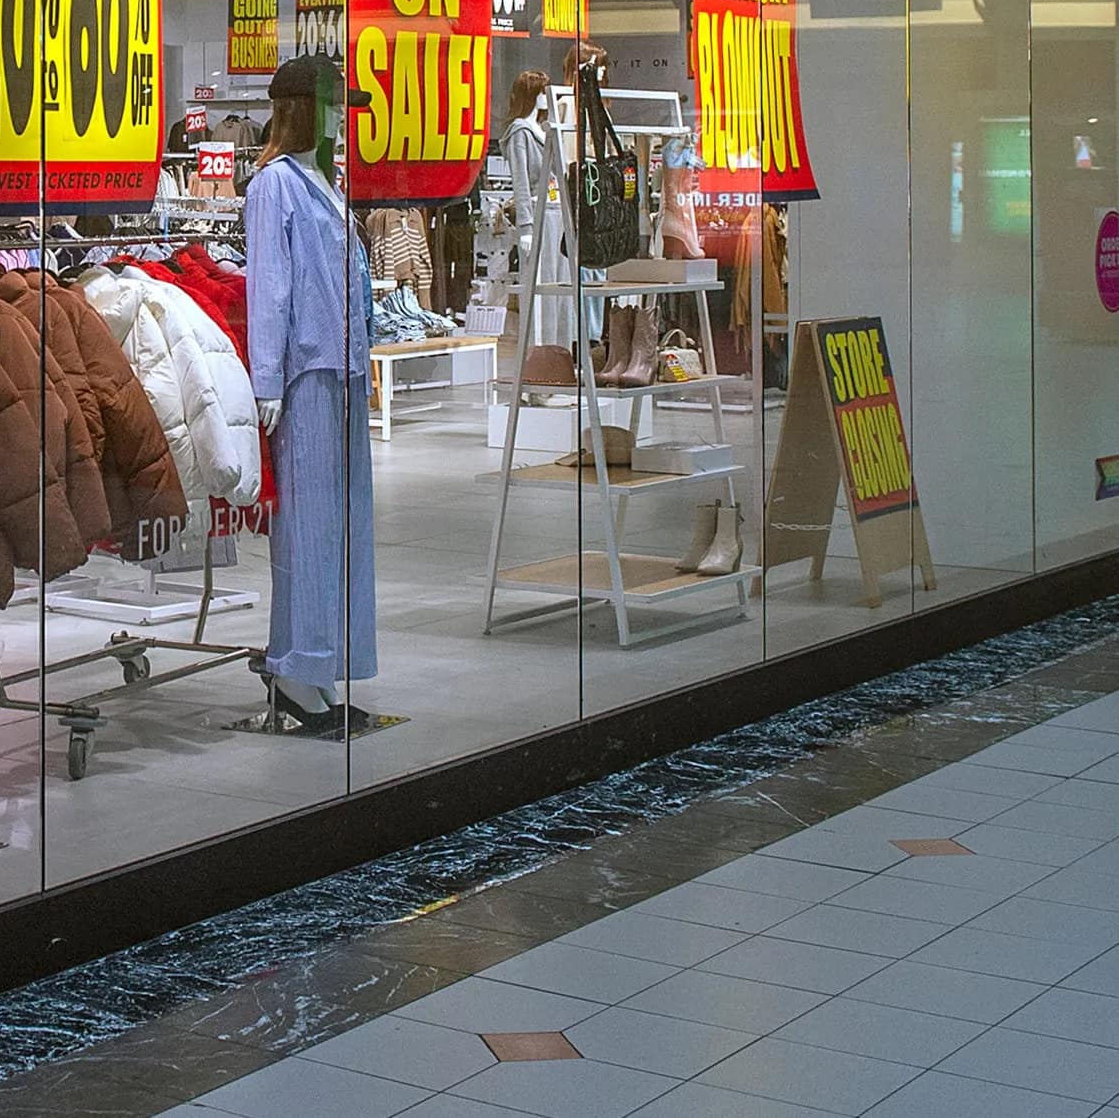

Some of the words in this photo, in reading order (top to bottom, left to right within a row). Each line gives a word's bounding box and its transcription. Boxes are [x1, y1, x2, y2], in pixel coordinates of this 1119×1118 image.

[234, 19, 264, 35] OUT
[231, 36, 278, 68] BUSINESS
[631, 59, 642, 68] IT
[653, 58, 668, 67] ON
[356, 25, 488, 165] SALE!
[698, 10, 800, 173] BLOWOUT
[104, 172, 144, 188] PRICE
[825, 329, 891, 403] STORE
[840, 401, 912, 501] CLOSING
[253, 500, 273, 538] 21
